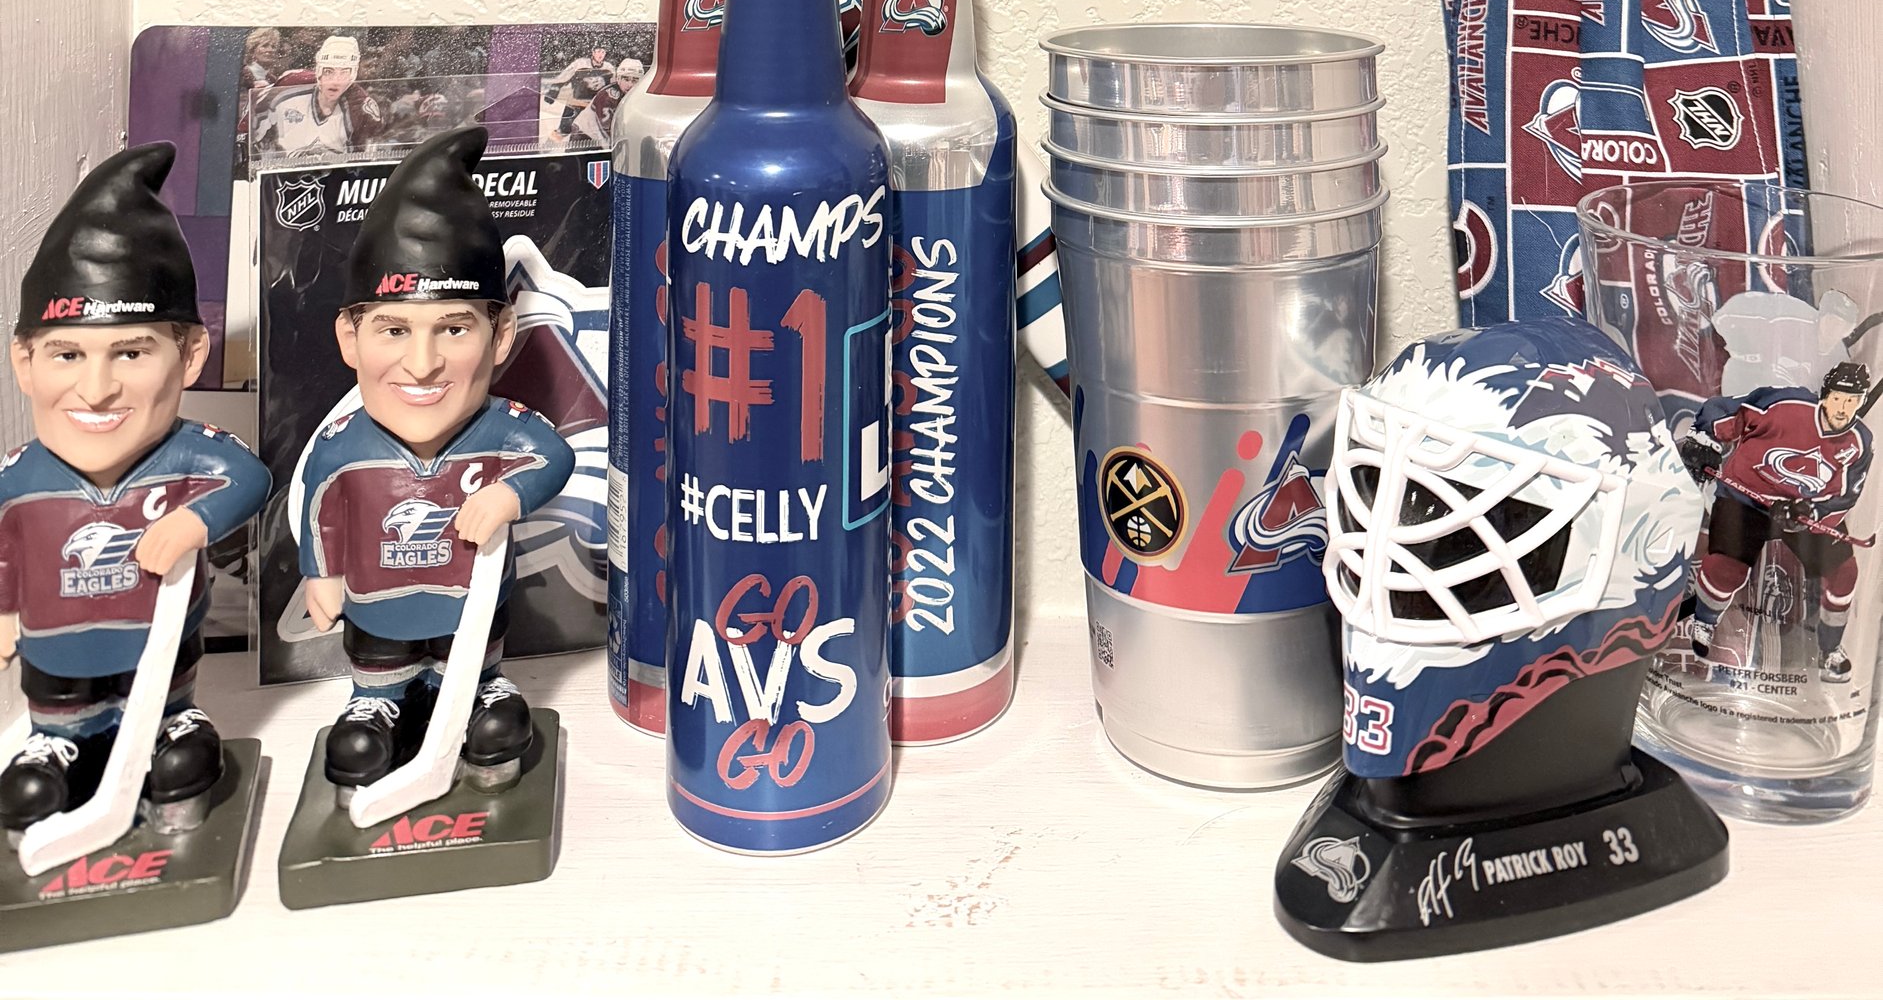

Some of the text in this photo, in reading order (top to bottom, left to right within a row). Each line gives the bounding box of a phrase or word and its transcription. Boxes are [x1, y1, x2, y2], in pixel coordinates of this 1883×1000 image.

[1687, 101, 1733, 136] NHL
[1581, 140, 1658, 165] COLORA
[287, 193, 316, 220] NHL
[489, 199, 537, 209] REMOVEABLE
[504, 209, 535, 218] RESIDUE
[681, 184, 887, 266] CHAMPS
[376, 273, 479, 296] ACE Hardware
[42, 297, 155, 320] ACE Hardware
[681, 281, 828, 465] #1
[906, 236, 961, 636] 2022 CHAMPIONS
[460, 462, 484, 494] C
[1724, 477, 1765, 503] EASTON
[142, 486, 168, 520] C
[680, 473, 828, 544] #CELLY
[383, 541, 451, 566] EAGLES
[395, 543, 438, 551] COLORADO
[63, 563, 137, 595] EAGLES
[77, 567, 123, 578] COLORADO
[715, 573, 820, 646] GO
[681, 617, 858, 726] AVS
[1718, 664, 1808, 684] PETER FORSBERG
[1729, 679, 1748, 690] #21
[1757, 684, 1798, 695] CENTER
[1700, 700, 1718, 712] logo
[1736, 710, 1778, 723] registered
[1780, 716, 1817, 724] trademark
[716, 719, 815, 791] GO
[371, 811, 490, 848] ACE
[369, 836, 483, 854] The helpful place.
[1482, 849, 1554, 886] PATRICK
[1550, 841, 1588, 871] ROY
[1602, 826, 1640, 866] 33
[42, 849, 175, 893] ACE
